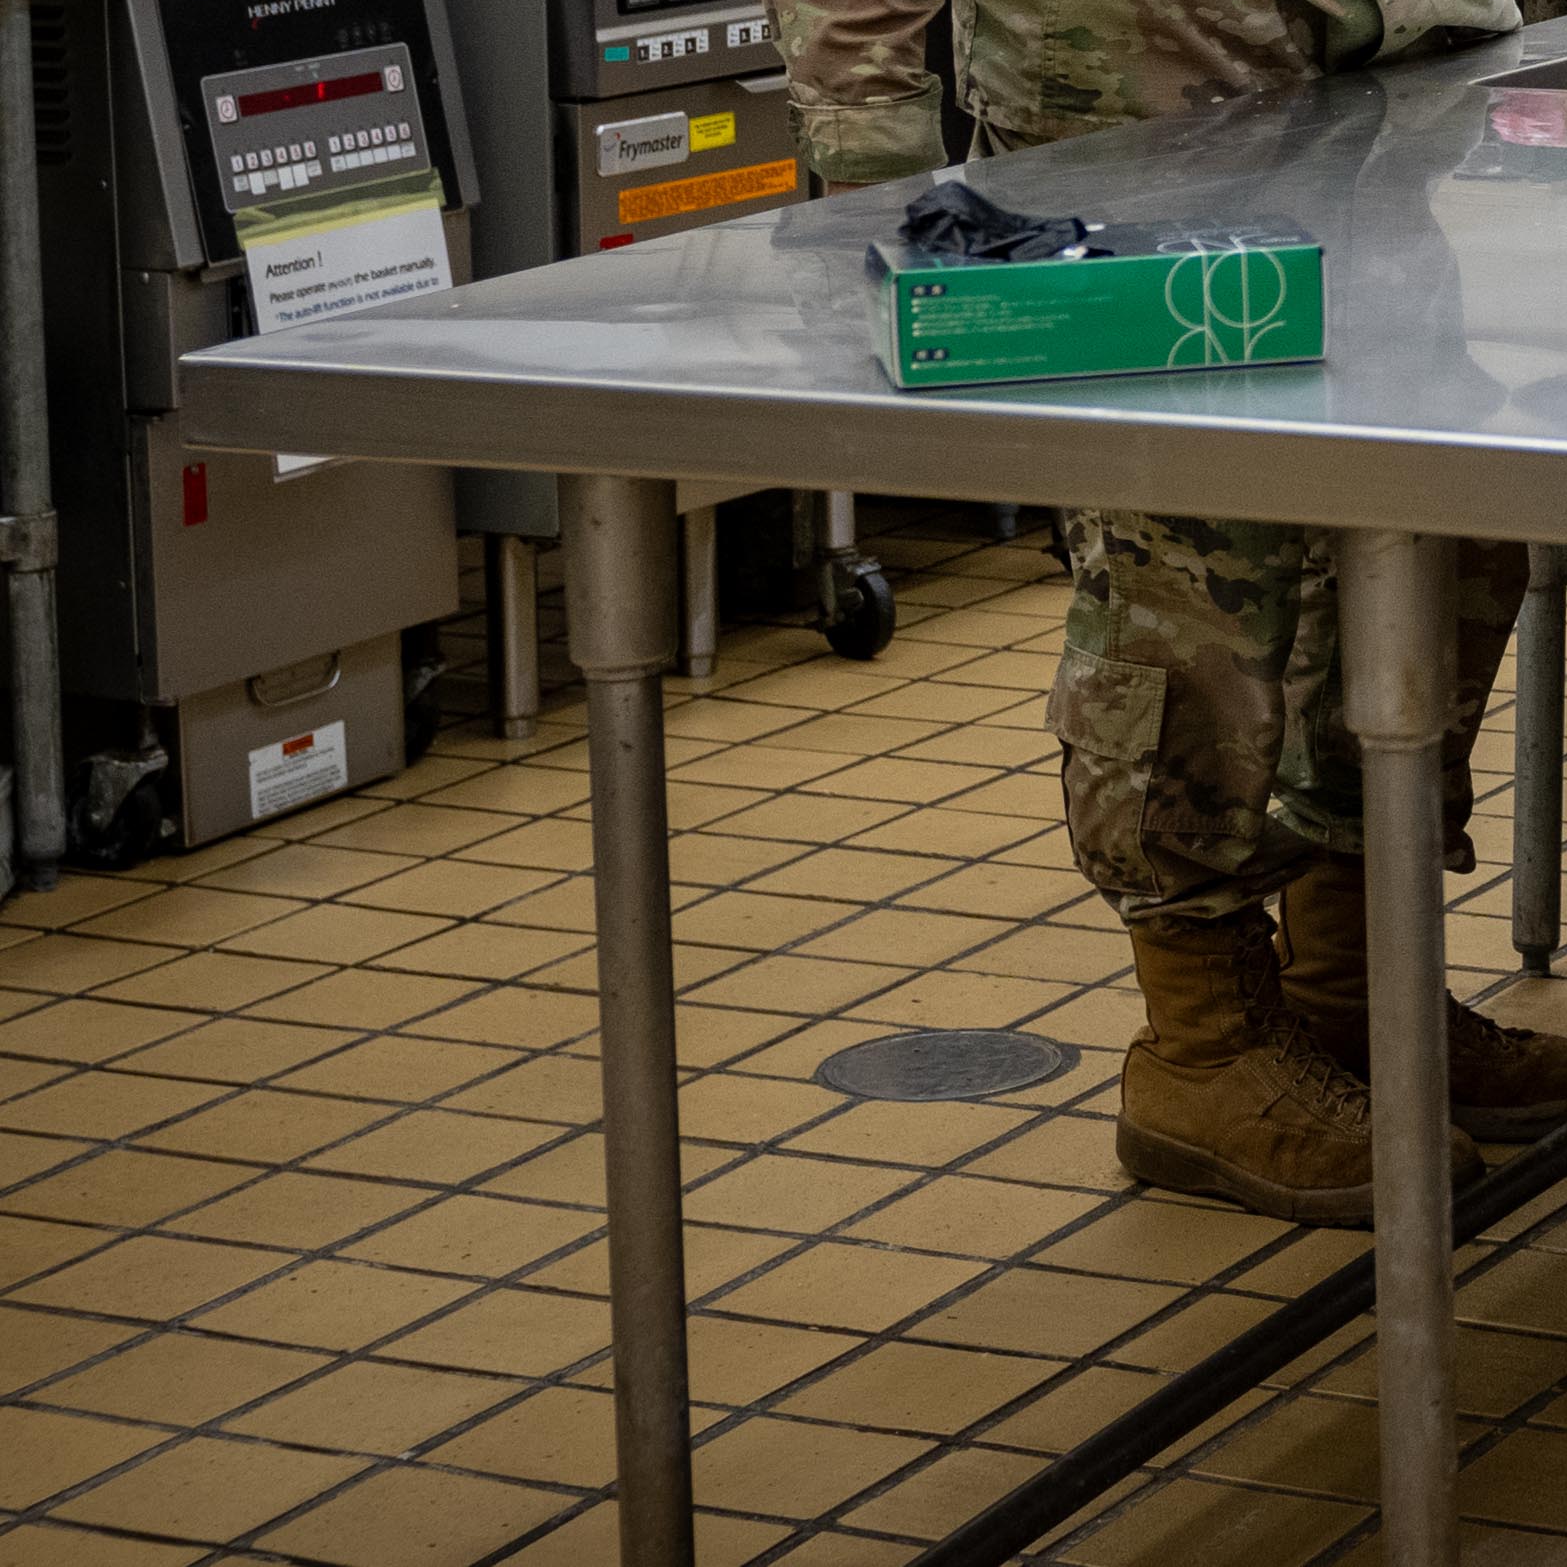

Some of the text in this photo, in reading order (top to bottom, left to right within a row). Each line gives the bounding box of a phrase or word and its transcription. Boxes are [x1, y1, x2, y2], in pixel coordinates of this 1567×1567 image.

[248, 0, 293, 18] HENNY
[618, 134, 683, 161] Frymaster
[266, 257, 315, 279] Attention
[269, 289, 294, 304] Please
[296, 284, 326, 299] operate
[354, 273, 369, 283] the
[371, 266, 398, 280] basket
[324, 295, 356, 312] function
[357, 294, 364, 303] is
[365, 291, 380, 302] not
[382, 283, 415, 299] available
[416, 278, 430, 292] due
[431, 277, 439, 286] to
